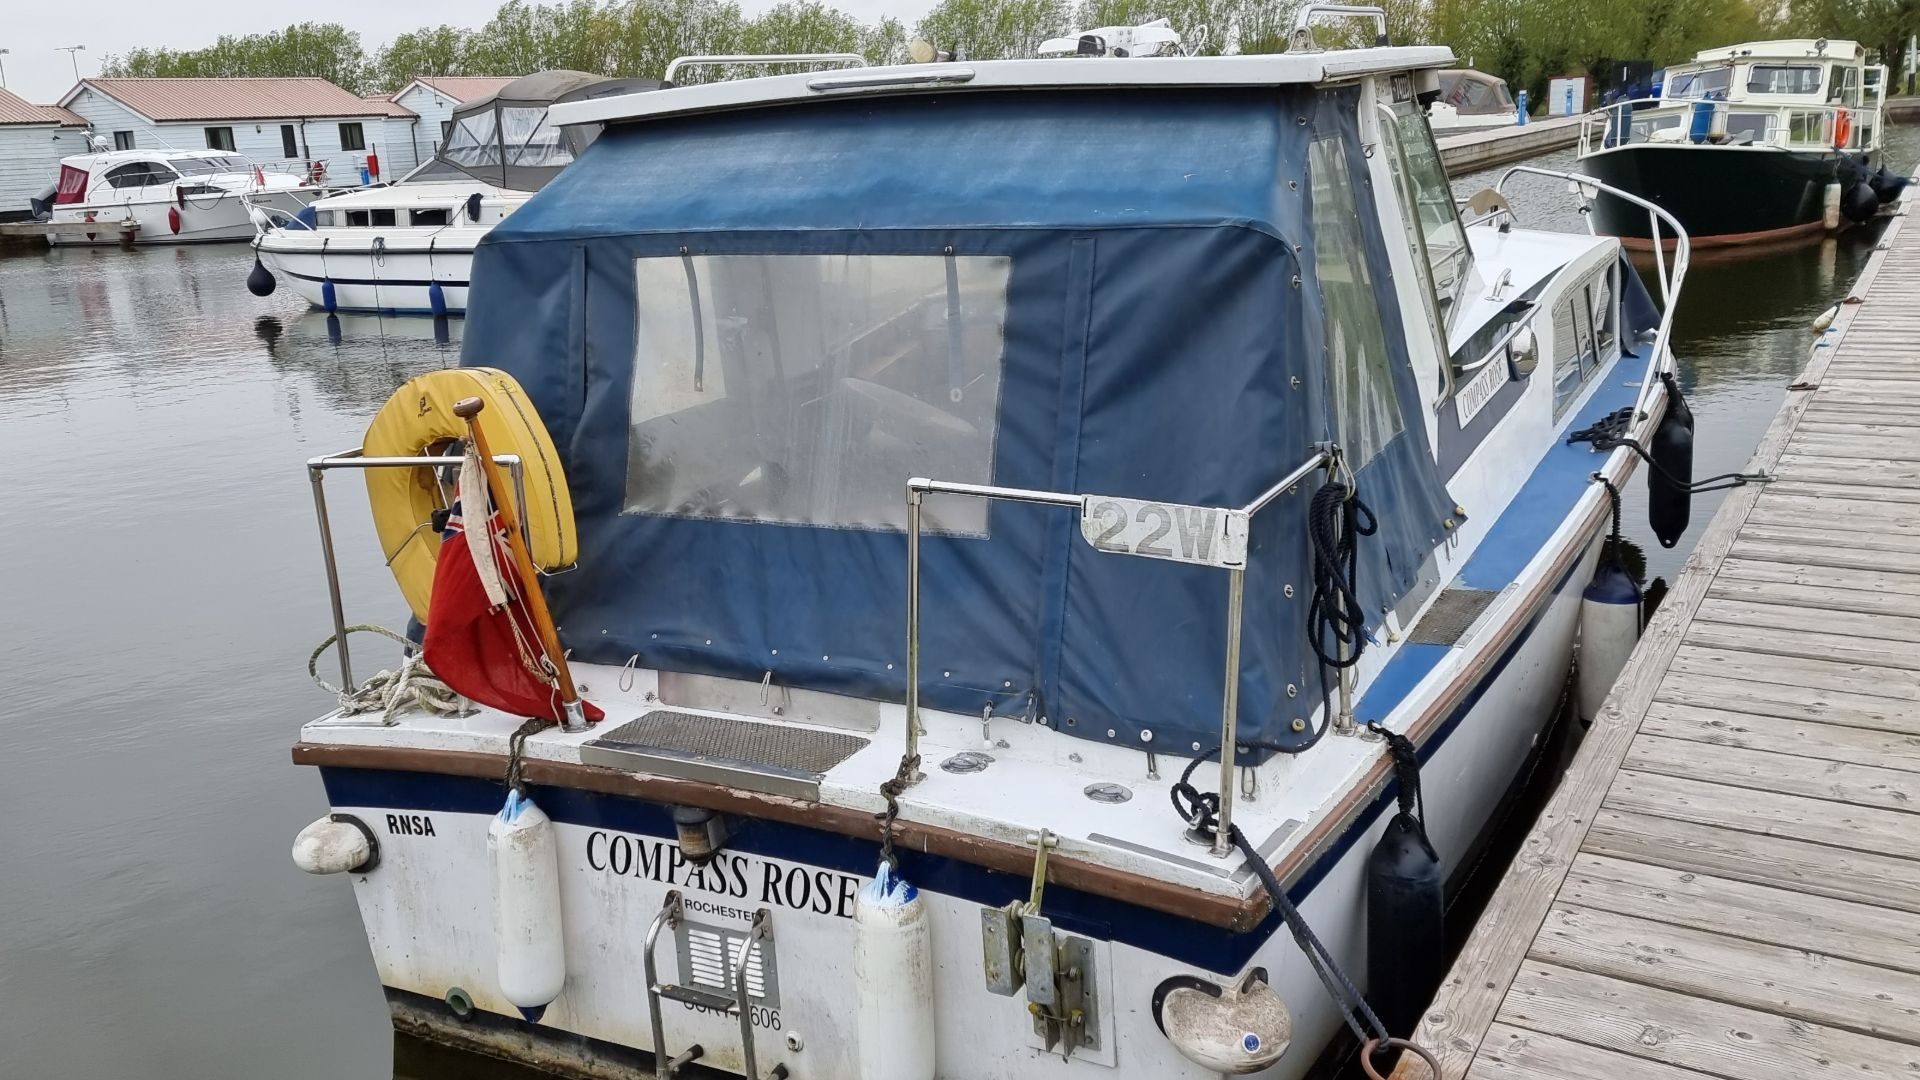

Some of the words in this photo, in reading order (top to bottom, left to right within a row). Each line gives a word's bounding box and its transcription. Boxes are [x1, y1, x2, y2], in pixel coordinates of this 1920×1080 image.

[1462, 372, 1490, 419] COMPASS
[1488, 358, 1504, 392] ROSE
[1092, 501, 1218, 561] 22W
[386, 814, 436, 837] RNSA
[586, 831, 749, 898] COMPASS
[760, 861, 860, 920] ROSE
